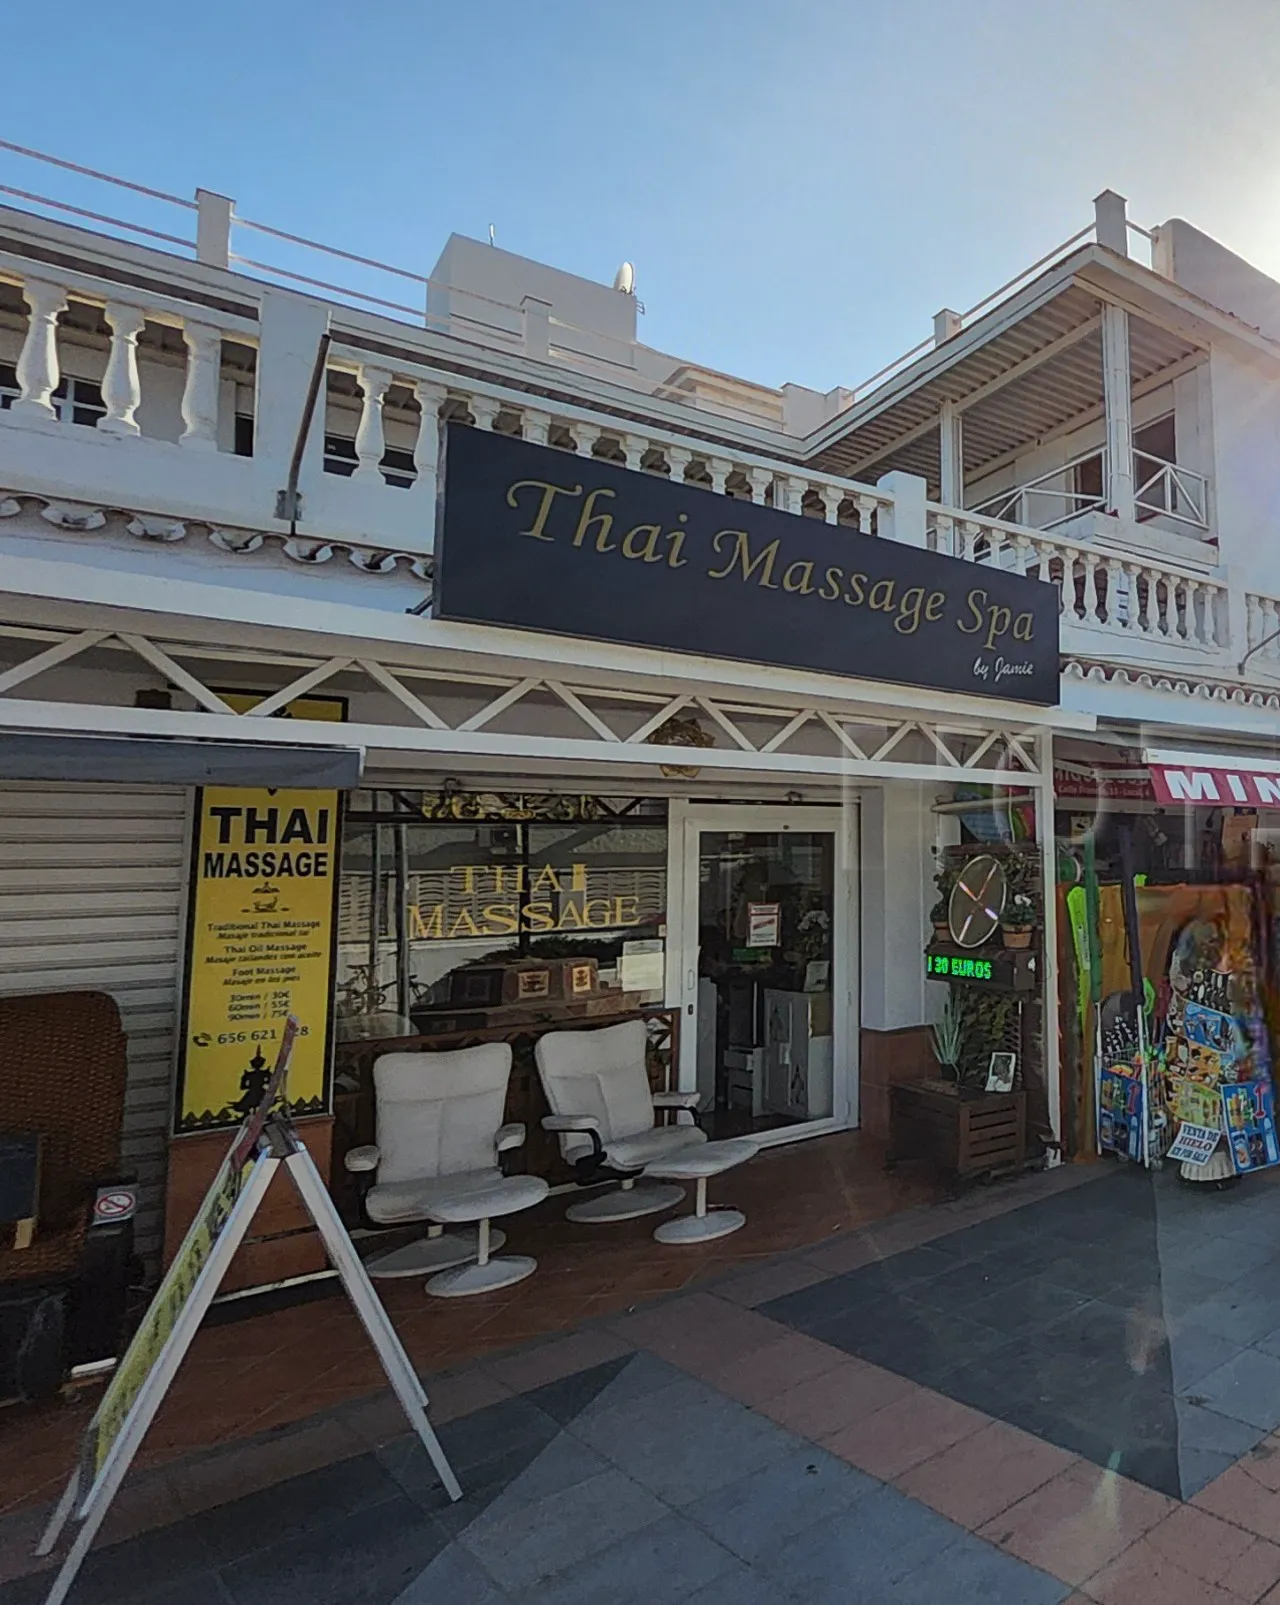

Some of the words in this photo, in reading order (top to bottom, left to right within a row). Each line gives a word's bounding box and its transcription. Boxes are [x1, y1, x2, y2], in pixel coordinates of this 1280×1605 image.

[506, 480, 688, 568] Thai
[708, 530, 946, 634] Massage
[957, 589, 1035, 650] Spa
[973, 656, 989, 680] by
[994, 656, 1034, 682] Jamie
[210, 807, 328, 844] THAI
[203, 852, 328, 878] MASSAGE
[450, 863, 588, 894] THAI
[207, 922, 258, 932] Traditional
[283, 921, 320, 929] Massage
[407, 896, 643, 941] MASSAGE
[224, 945, 246, 953] Thai
[266, 943, 307, 952] Massage
[232, 968, 254, 976] Foot
[256, 966, 296, 975] Massage
[934, 956, 949, 974] 30
[951, 958, 992, 979] EUROS
[230, 993, 261, 1002] 30min
[228, 1003, 261, 1012] 60min
[218, 1031, 246, 1044] 656
[251, 1029, 276, 1041] 621
[1179, 1136, 1212, 1151] HIELO
